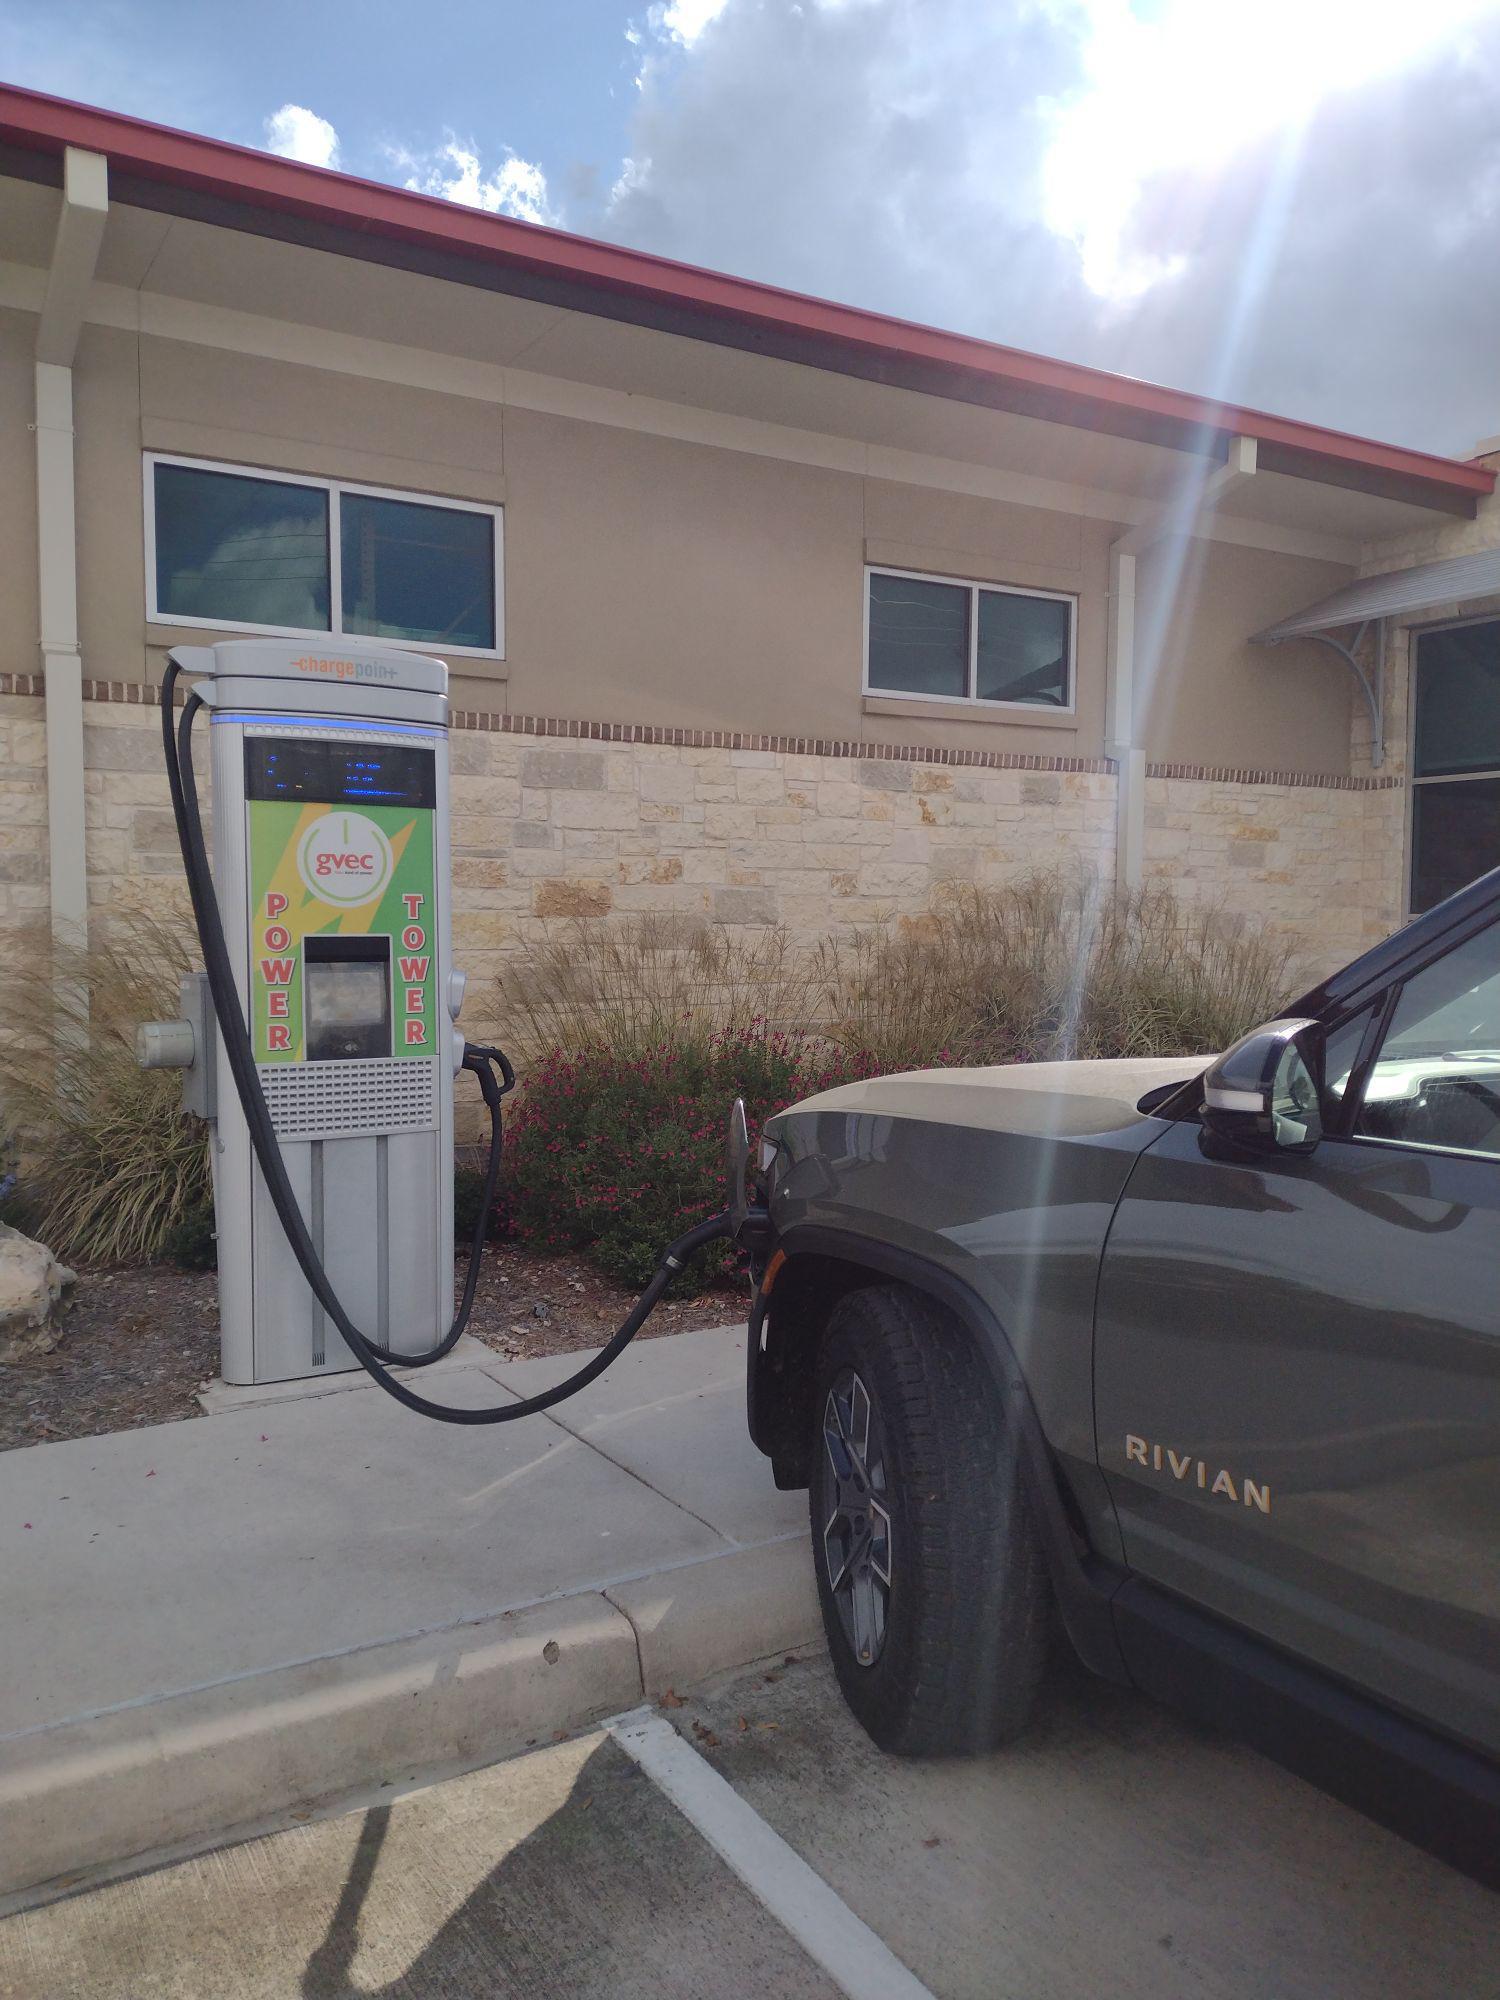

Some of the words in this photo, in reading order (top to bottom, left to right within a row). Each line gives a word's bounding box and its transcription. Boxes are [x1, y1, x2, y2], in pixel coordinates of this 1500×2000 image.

[316, 853, 374, 876] gvec
[261, 892, 295, 1051] POWER
[399, 894, 430, 1045] TOWER
[1125, 1433, 1271, 1514] RIVIAN
